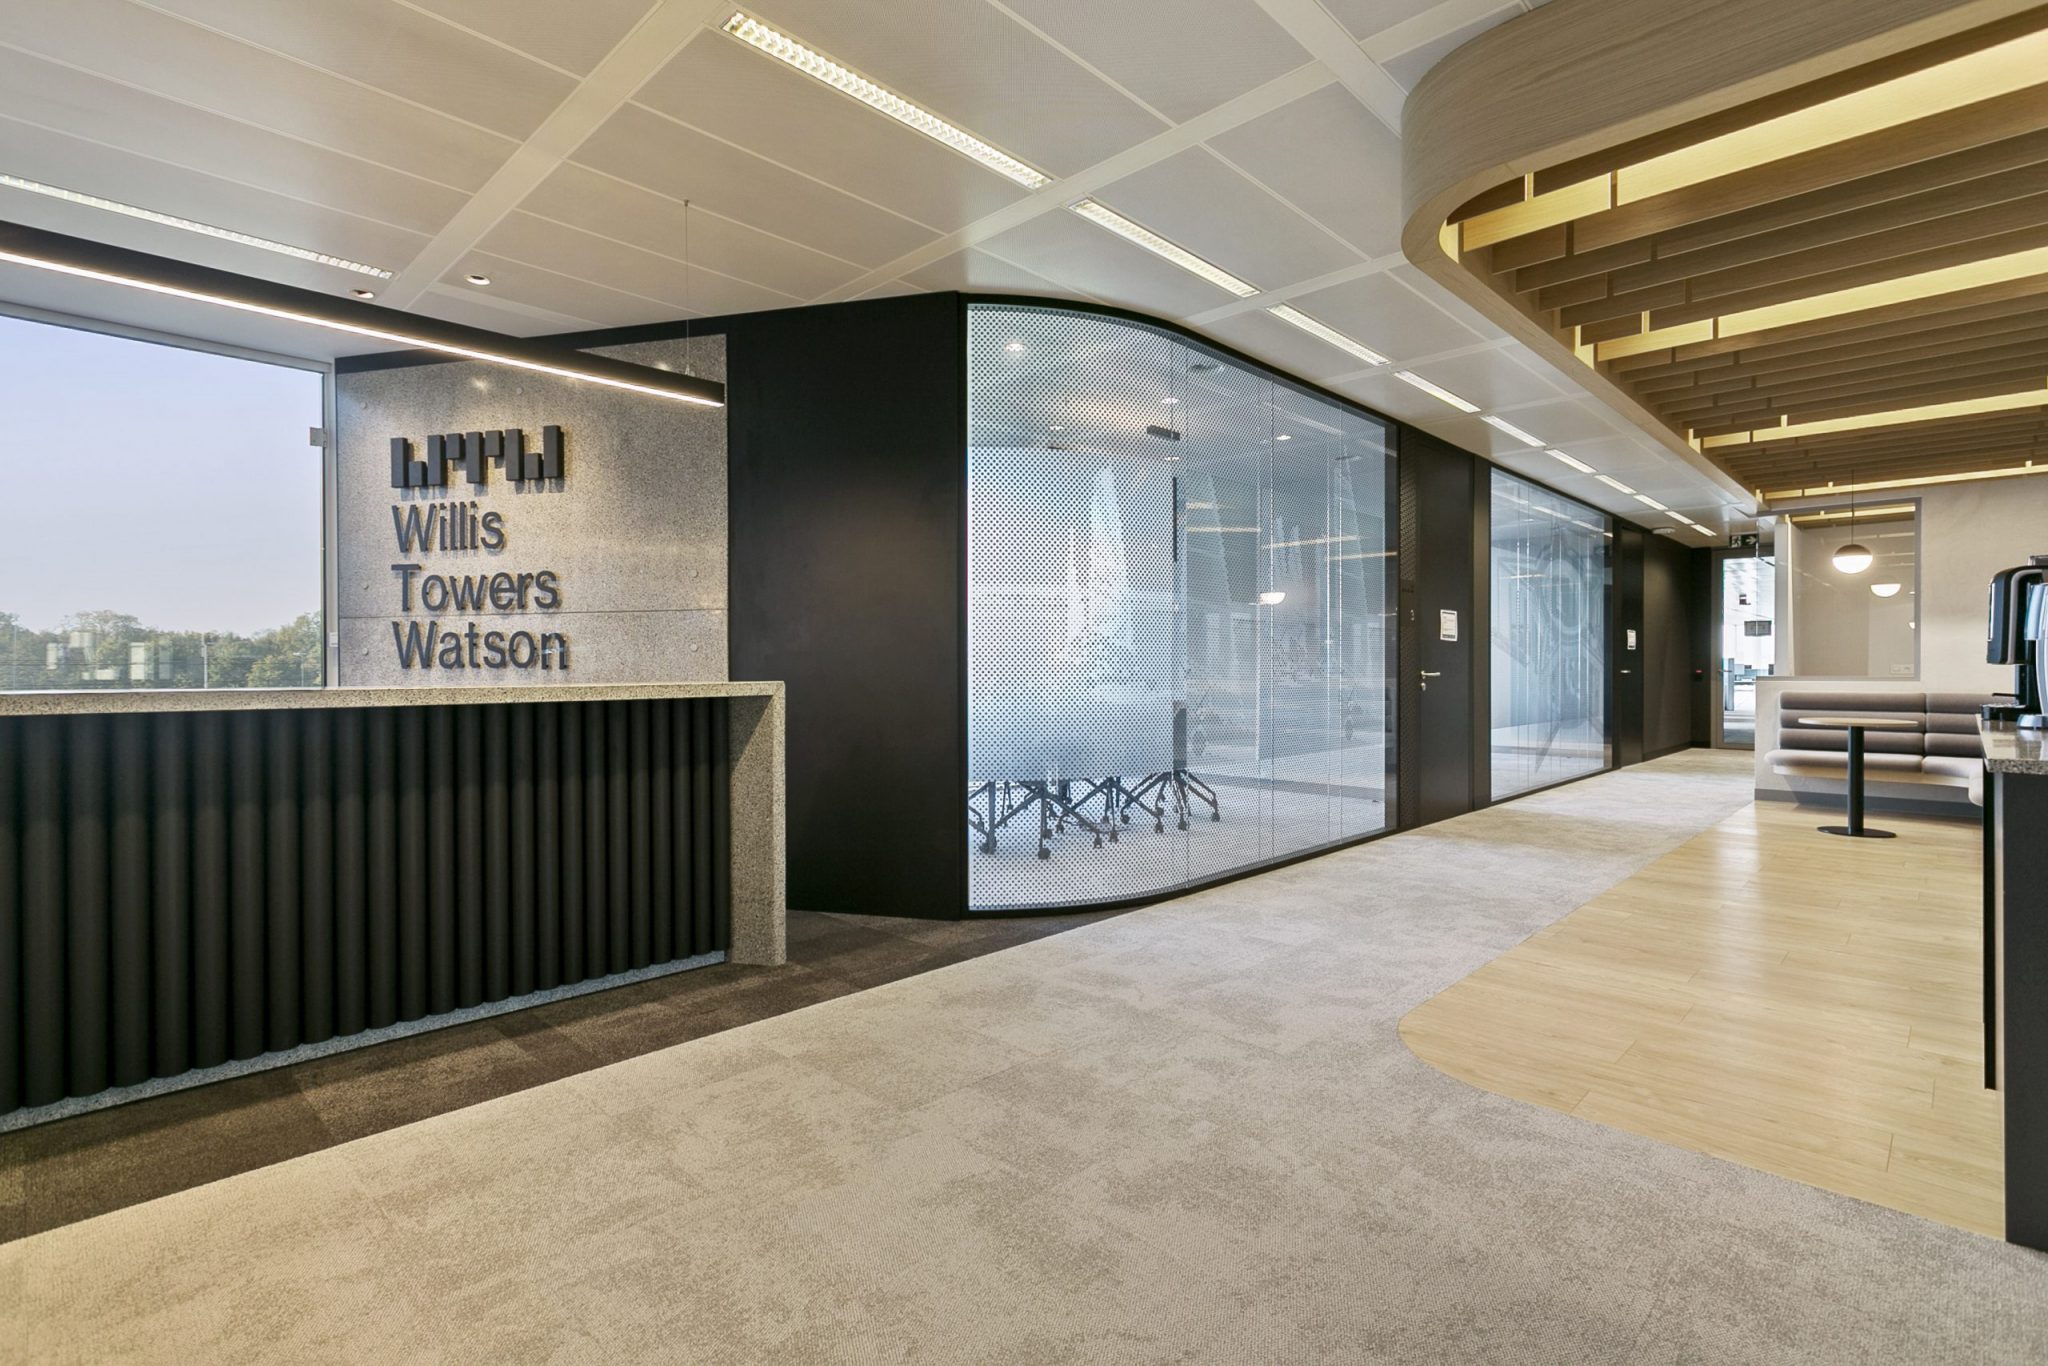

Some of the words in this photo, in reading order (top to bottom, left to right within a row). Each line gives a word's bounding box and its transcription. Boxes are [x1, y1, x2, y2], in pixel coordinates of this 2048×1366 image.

[390, 501, 505, 553] Willis
[390, 563, 559, 612] Towers
[390, 620, 569, 670] Watson
